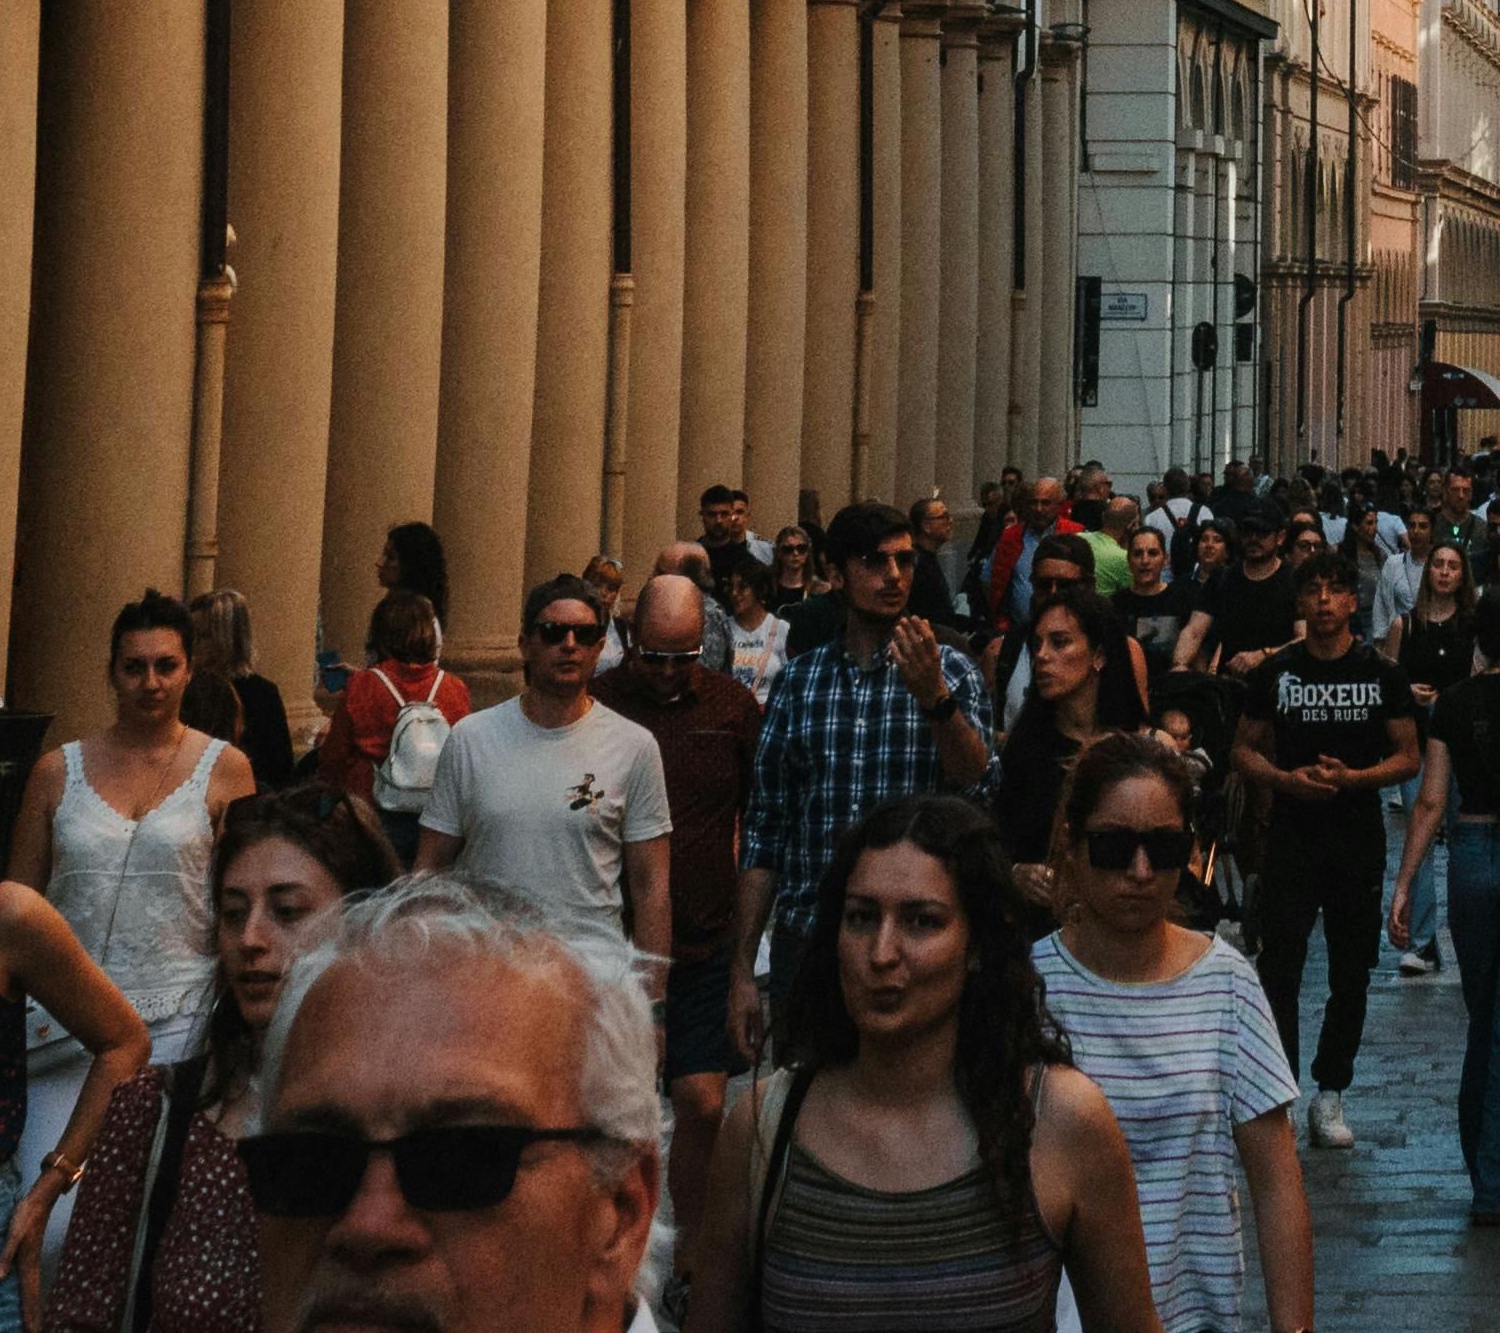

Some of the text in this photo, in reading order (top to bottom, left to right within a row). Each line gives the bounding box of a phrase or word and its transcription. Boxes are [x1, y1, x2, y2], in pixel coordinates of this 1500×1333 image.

[1289, 682, 1383, 707] BOXEUR
[1302, 708, 1369, 722] DES RUES
